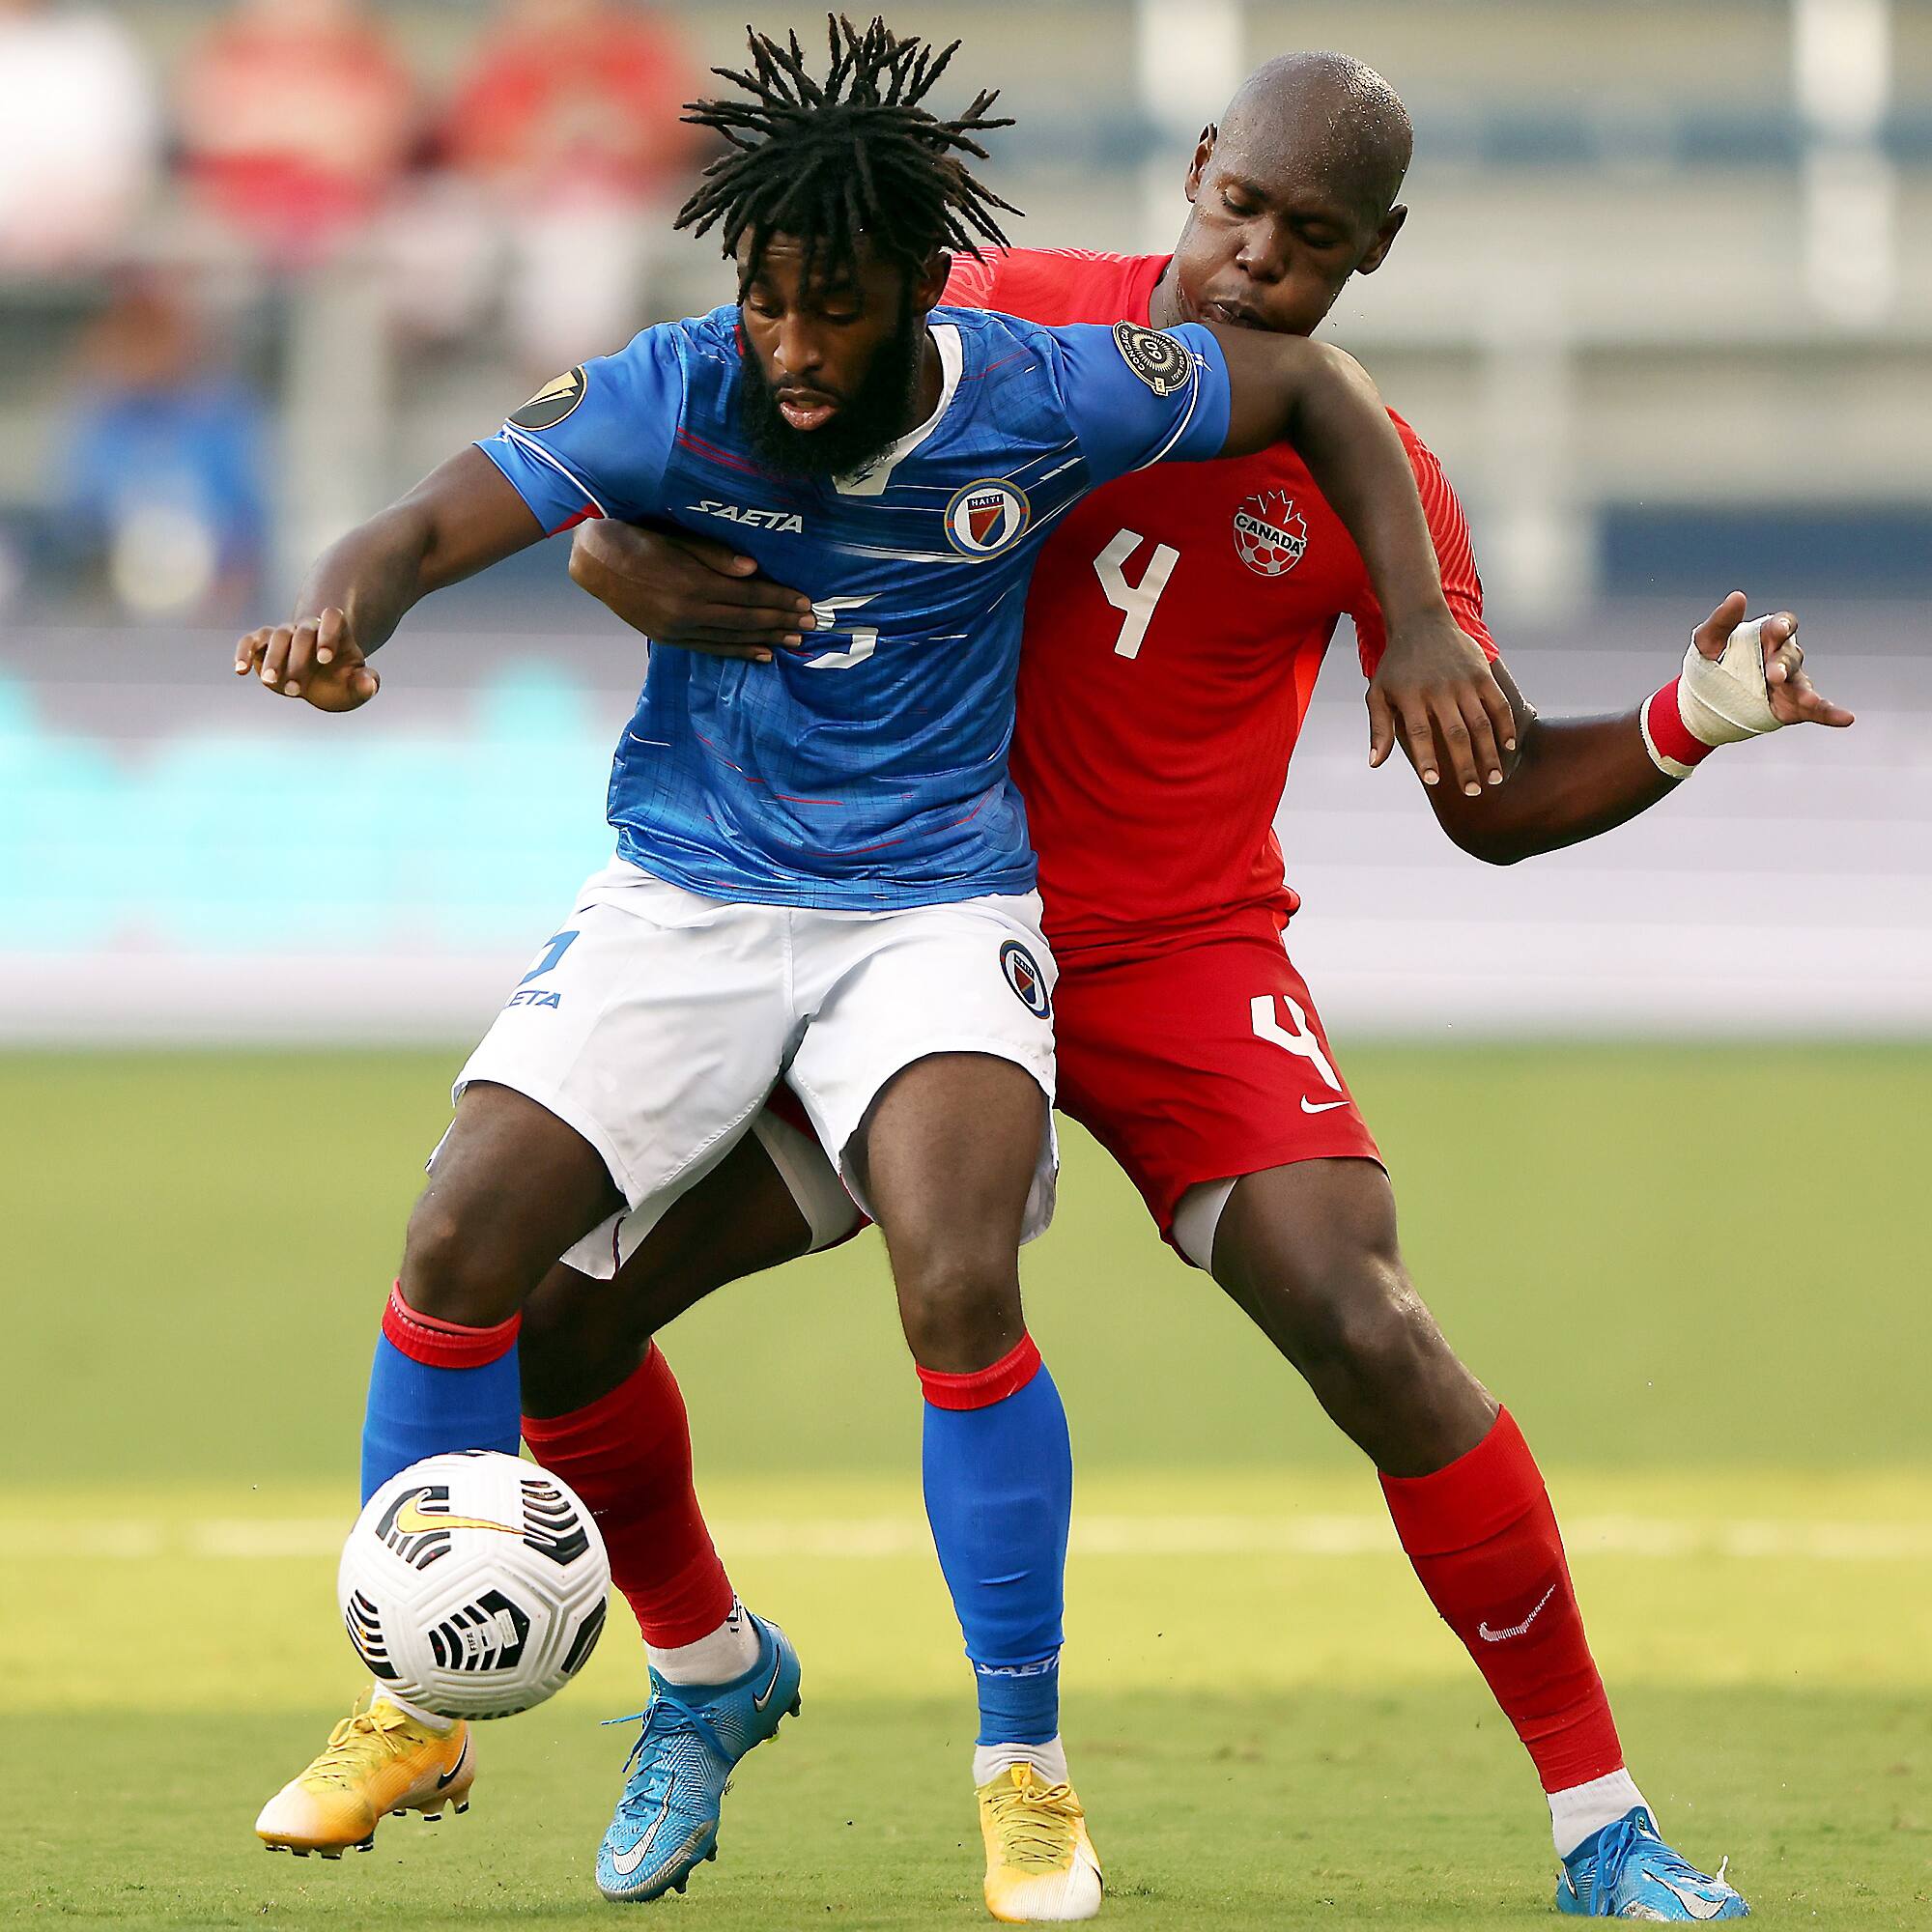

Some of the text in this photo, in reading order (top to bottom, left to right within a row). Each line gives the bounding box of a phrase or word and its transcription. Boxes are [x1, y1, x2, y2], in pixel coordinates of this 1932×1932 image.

[1144, 341, 1162, 360] 60
[685, 499, 804, 534] SAETA
[971, 496, 1000, 507] HAITI
[1235, 514, 1301, 556] CANADA
[1093, 527, 1180, 660] 4
[804, 592, 883, 669] 5
[1250, 994, 1344, 1093] 4
